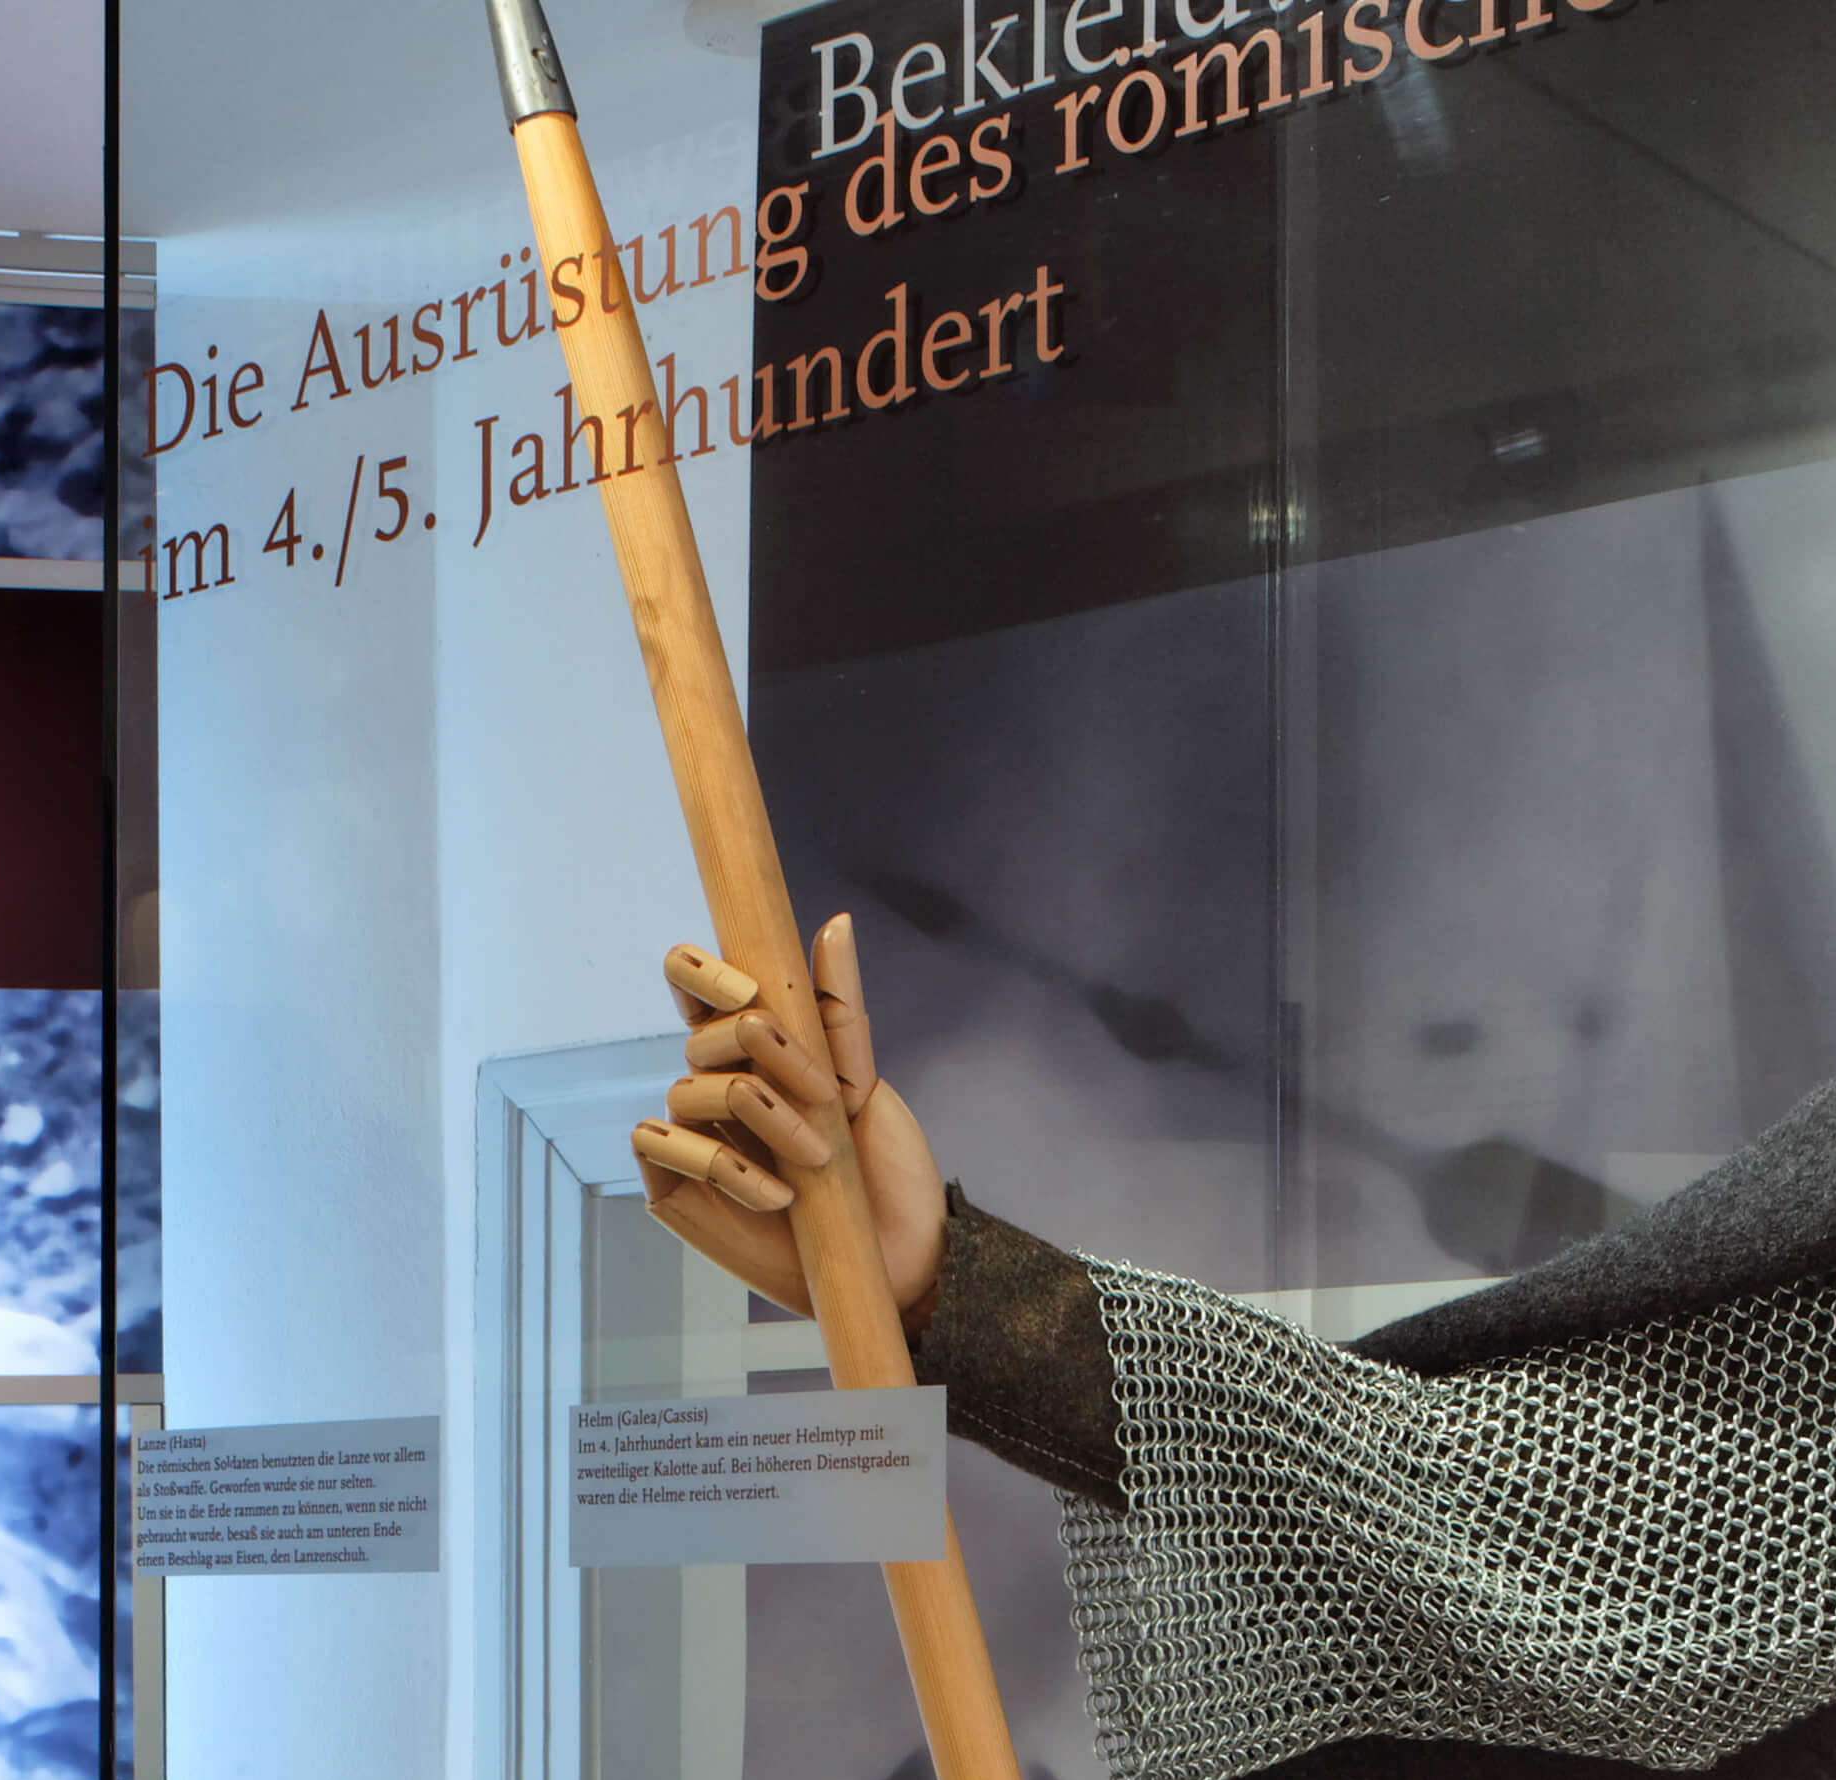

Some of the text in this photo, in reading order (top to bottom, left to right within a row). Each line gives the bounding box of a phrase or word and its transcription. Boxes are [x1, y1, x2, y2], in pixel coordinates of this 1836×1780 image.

[141, 0, 1614, 459] Die Ausrüstung des römisc
[137, 265, 1065, 607] im 4./5. Jahrhundert
[577, 1406, 708, 1430] Helm (Galea/Cassis)
[136, 1433, 206, 1454] Lanze (Hasta)
[577, 1423, 884, 1456] Im 4. Jahrhundert kam ein neuer Helmtyp mit
[136, 1459, 155, 1475] Die
[156, 1456, 211, 1473] römischen
[260, 1452, 315, 1469] benutzten
[316, 1449, 335, 1466] die
[337, 1449, 371, 1465] Lanze
[371, 1451, 391, 1464] vor
[393, 1445, 426, 1463] allem
[576, 1449, 910, 1482] zweiteiliger Kalotte auf. Bei höheren Dienstgraden
[576, 1482, 779, 1505] waren die Helme reich verziert.
